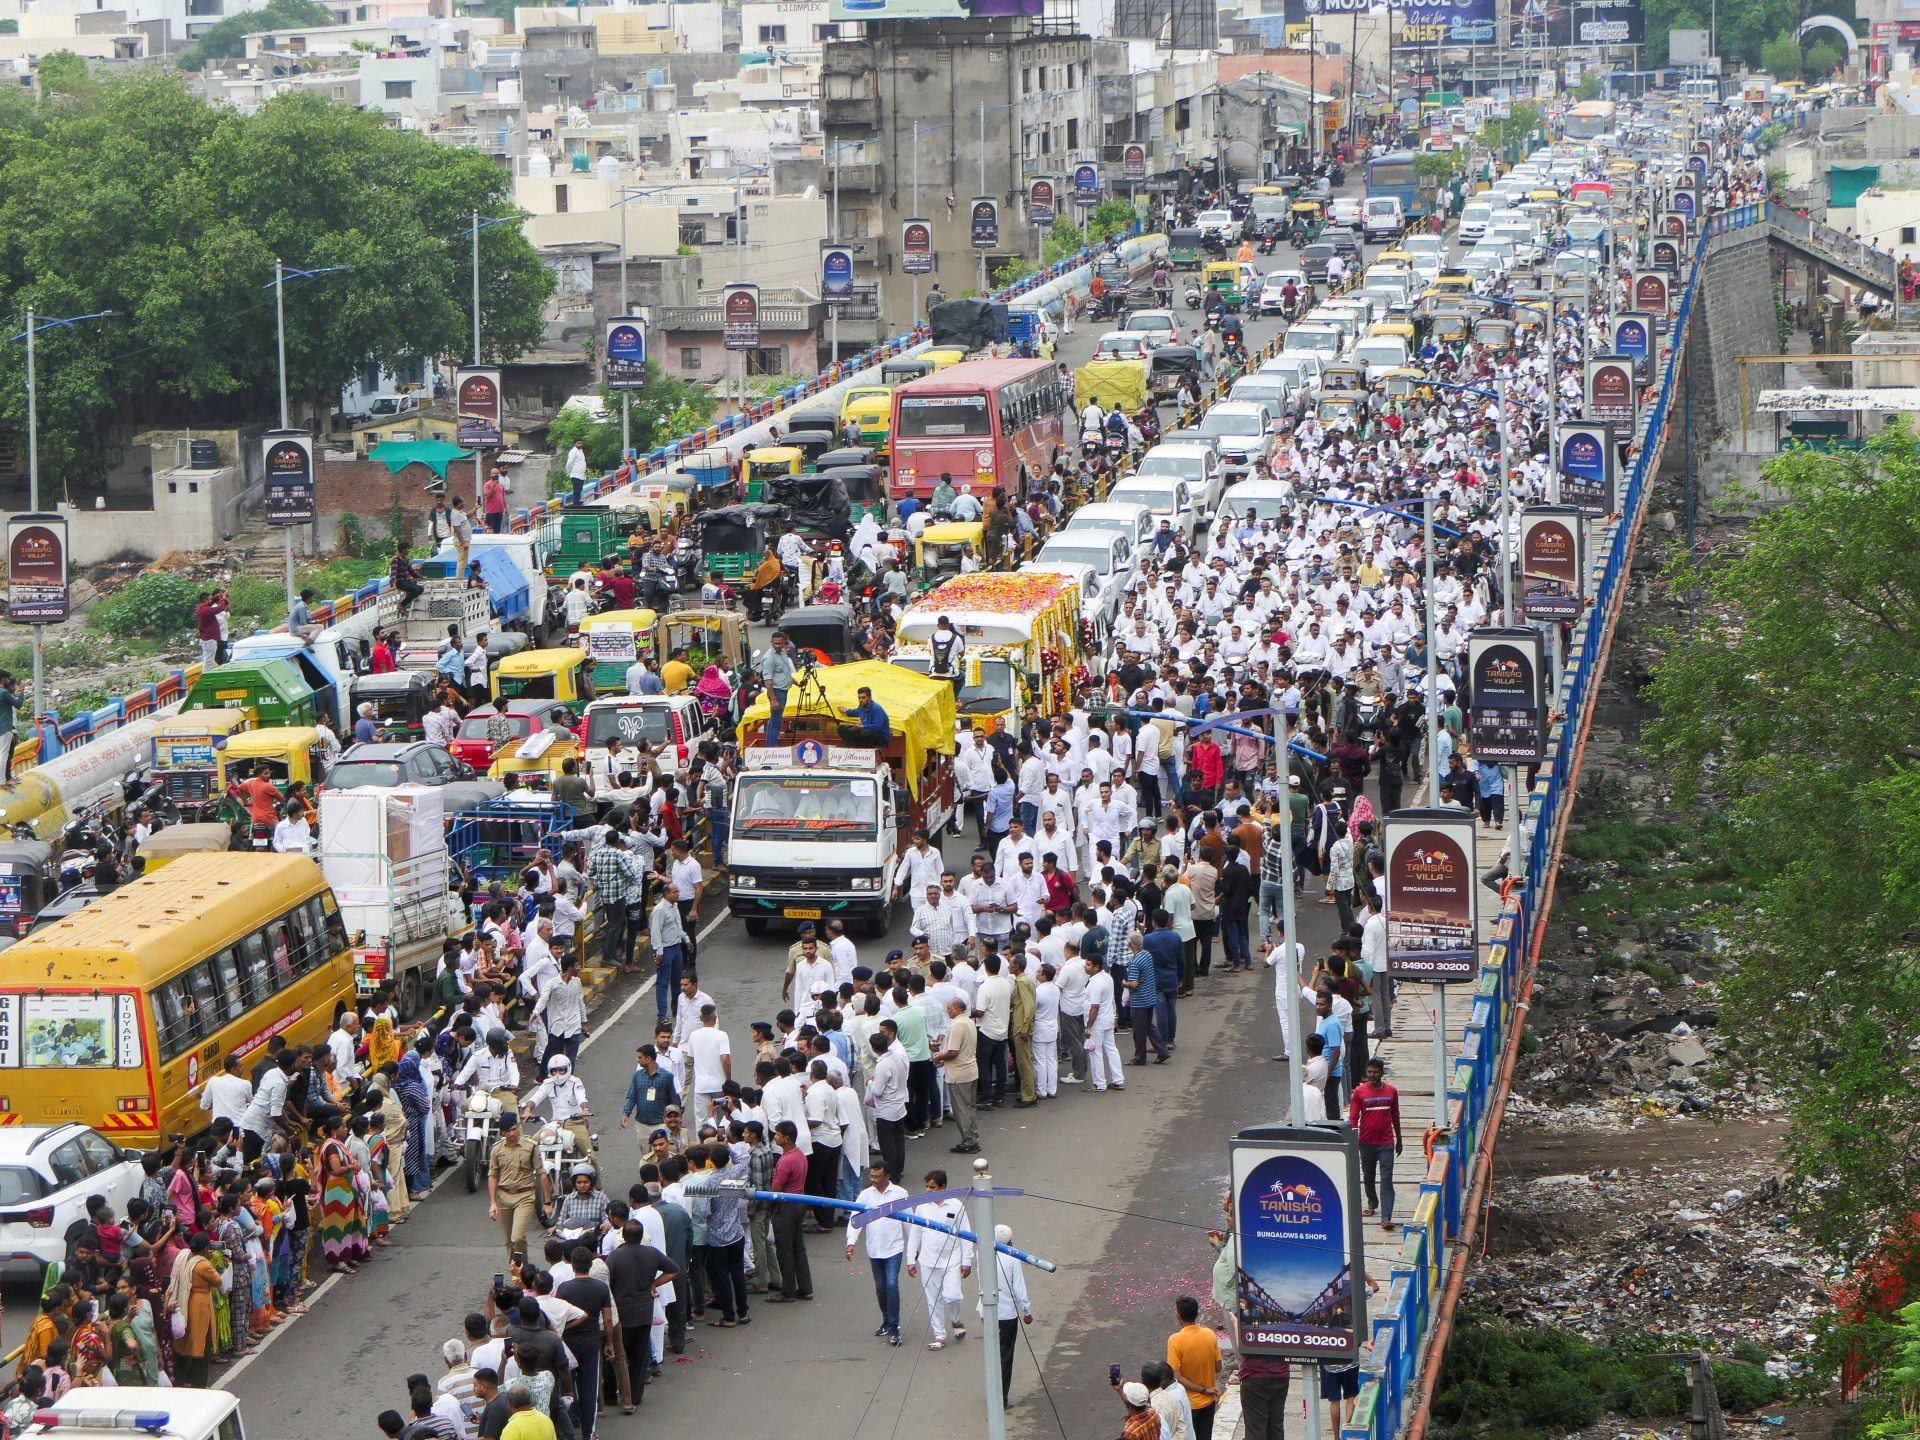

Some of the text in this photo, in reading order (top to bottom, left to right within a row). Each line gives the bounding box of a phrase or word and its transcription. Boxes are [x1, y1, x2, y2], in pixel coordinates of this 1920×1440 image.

[1402, 25, 1447, 42] NEET
[1485, 670, 1523, 678] TANISHQ
[224, 699, 243, 708] DUTY
[749, 750, 762, 761] Jay
[1482, 747, 1536, 756] 84900 30200
[1405, 863, 1453, 873] TANISHQ
[1415, 873, 1444, 881] VILLA
[1400, 961, 1470, 971] 84900 30200
[122, 997, 132, 1065] VIDYAPITH
[203, 1041, 220, 1062] GARDI
[1259, 1200, 1323, 1213] TANISHQ
[1273, 1213, 1310, 1224] VILLA
[1256, 1231, 1298, 1239] BUNGALOWS
[1304, 1233, 1327, 1241] SHOPS
[1257, 1332, 1347, 1347] 84900 30200
